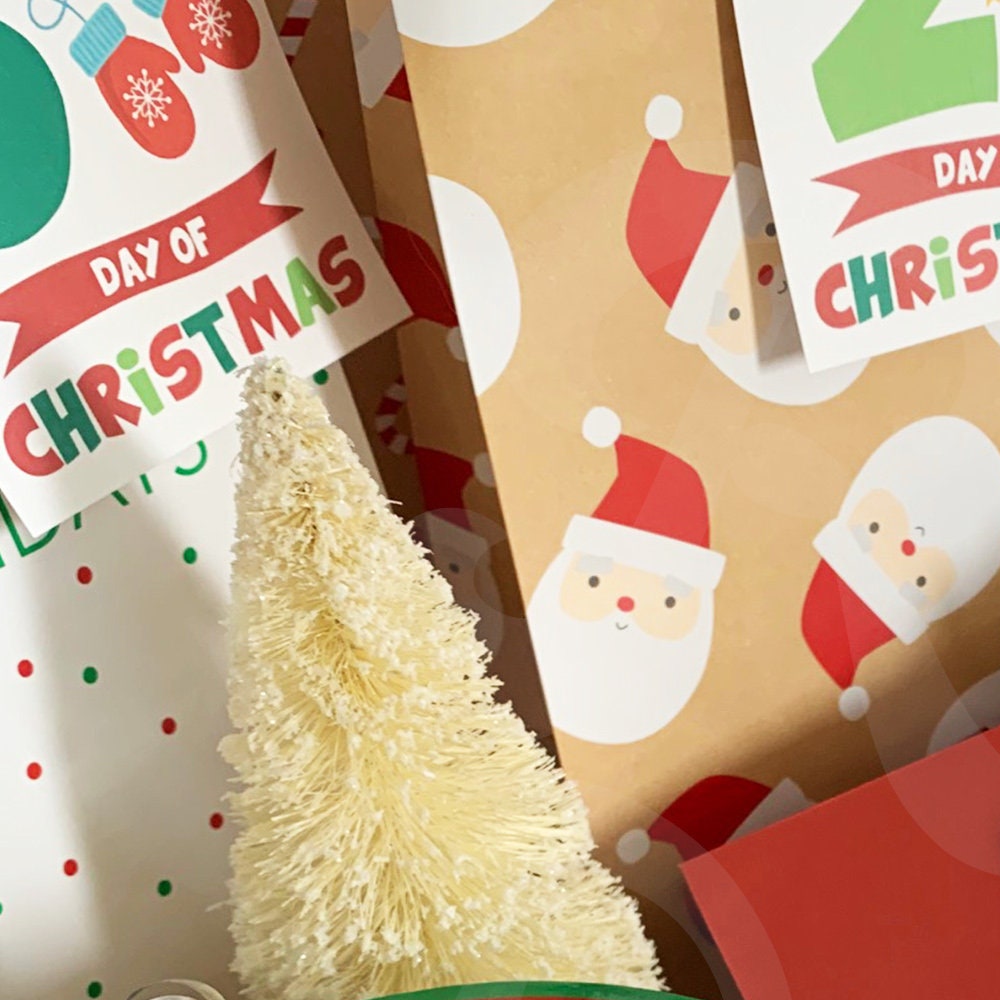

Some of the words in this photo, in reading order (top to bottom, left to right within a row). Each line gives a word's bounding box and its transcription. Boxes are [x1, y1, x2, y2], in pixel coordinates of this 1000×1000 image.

[933, 143, 997, 189] DAY
[89, 237, 160, 296] DAY
[169, 216, 209, 264] OF
